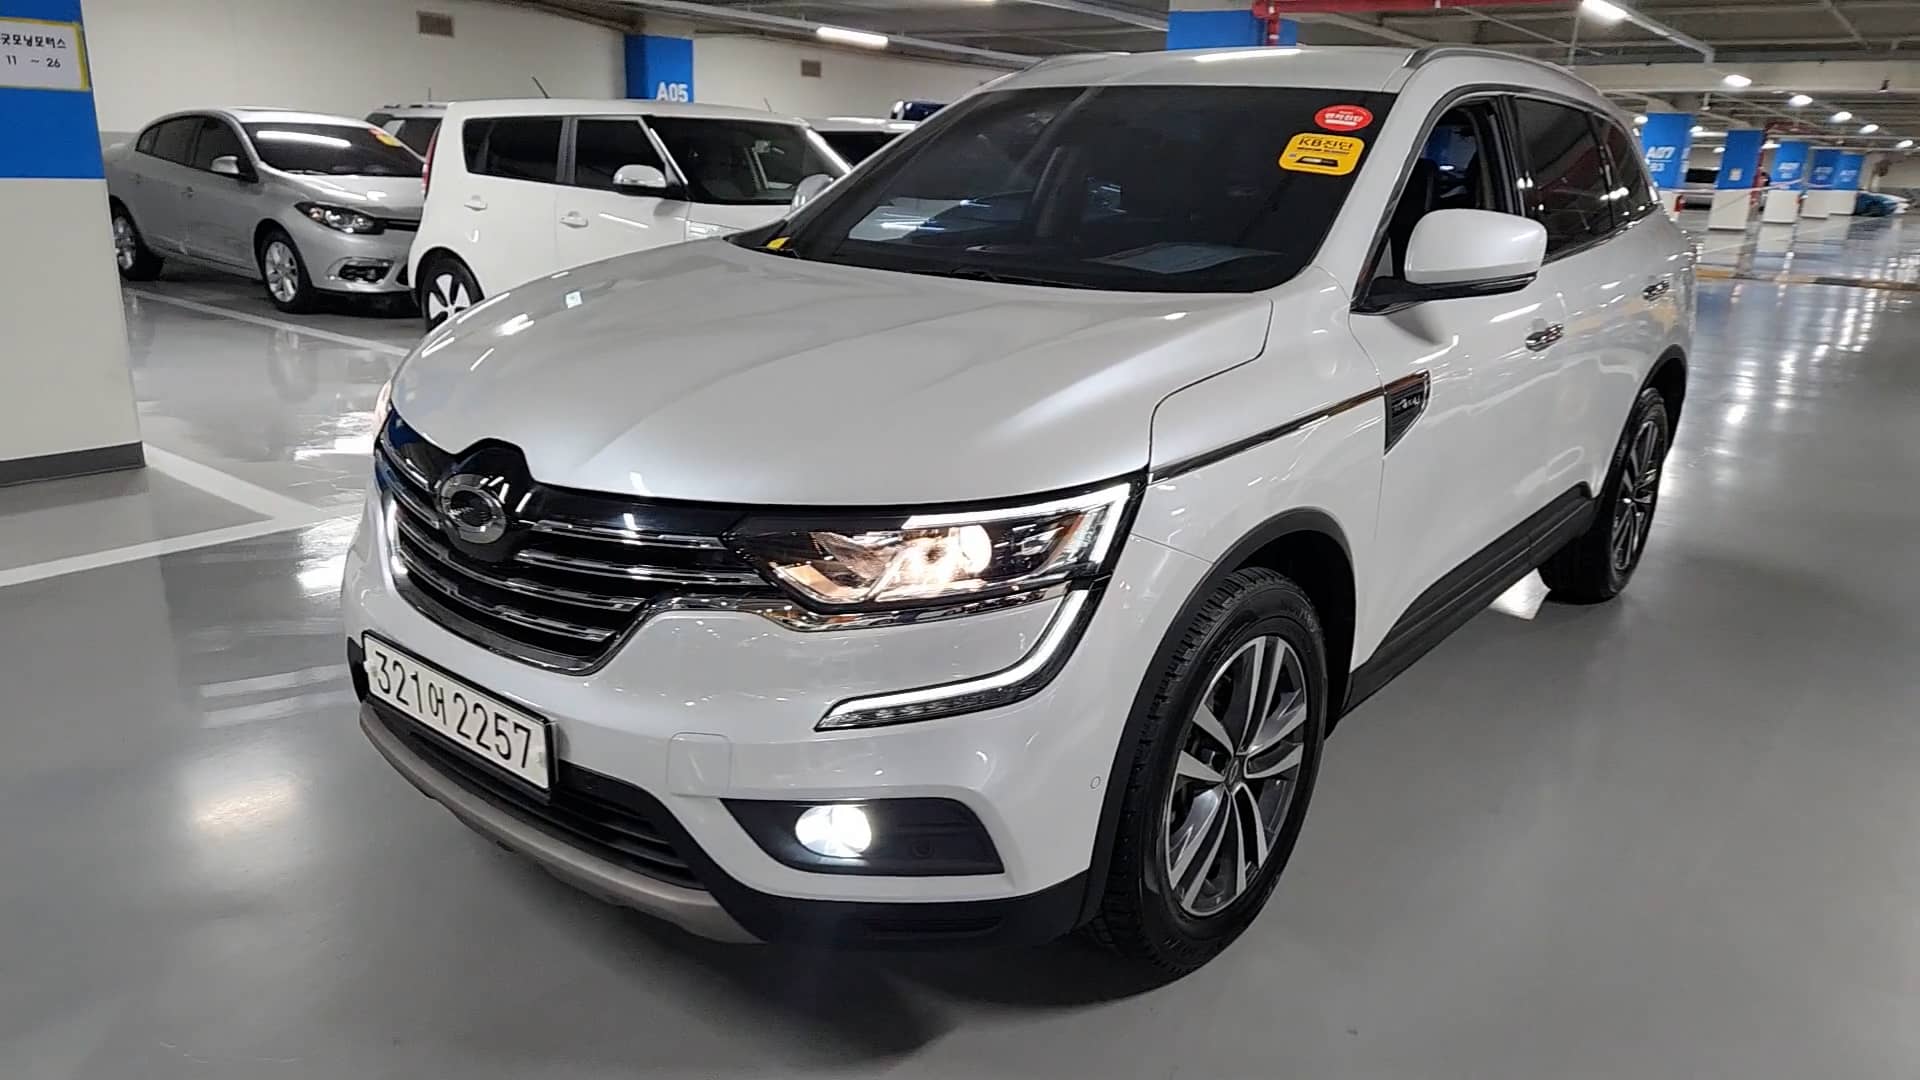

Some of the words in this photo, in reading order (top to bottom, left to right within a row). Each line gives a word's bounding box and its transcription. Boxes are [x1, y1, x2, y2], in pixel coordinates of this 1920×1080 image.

[6, 55, 17, 66] 11
[46, 57, 61, 68] 26
[656, 81, 689, 102] A05
[1299, 138, 1353, 150] KB진단
